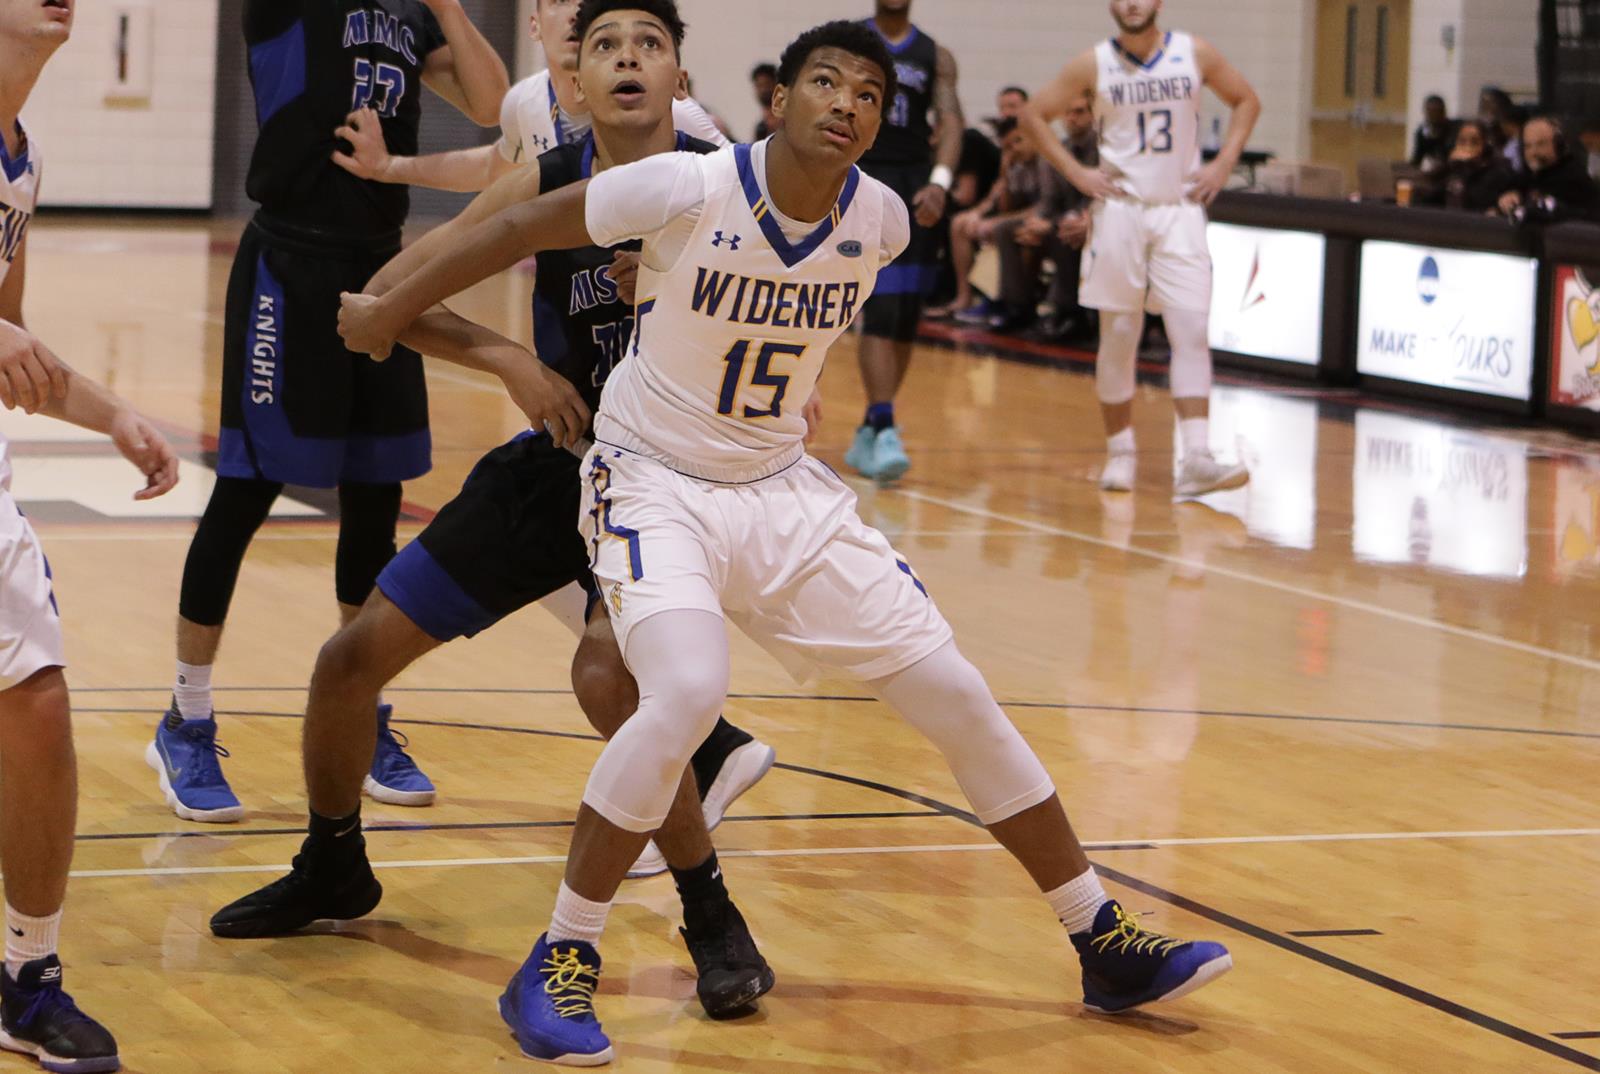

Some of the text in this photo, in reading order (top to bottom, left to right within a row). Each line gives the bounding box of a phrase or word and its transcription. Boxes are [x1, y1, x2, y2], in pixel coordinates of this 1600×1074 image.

[1108, 76, 1192, 107] WIDENER
[1137, 109, 1172, 154] 13
[690, 265, 860, 330] WIDENER
[251, 294, 277, 405] KNIGHTS
[1369, 326, 1417, 360] MAKE
[715, 337, 808, 419] 15
